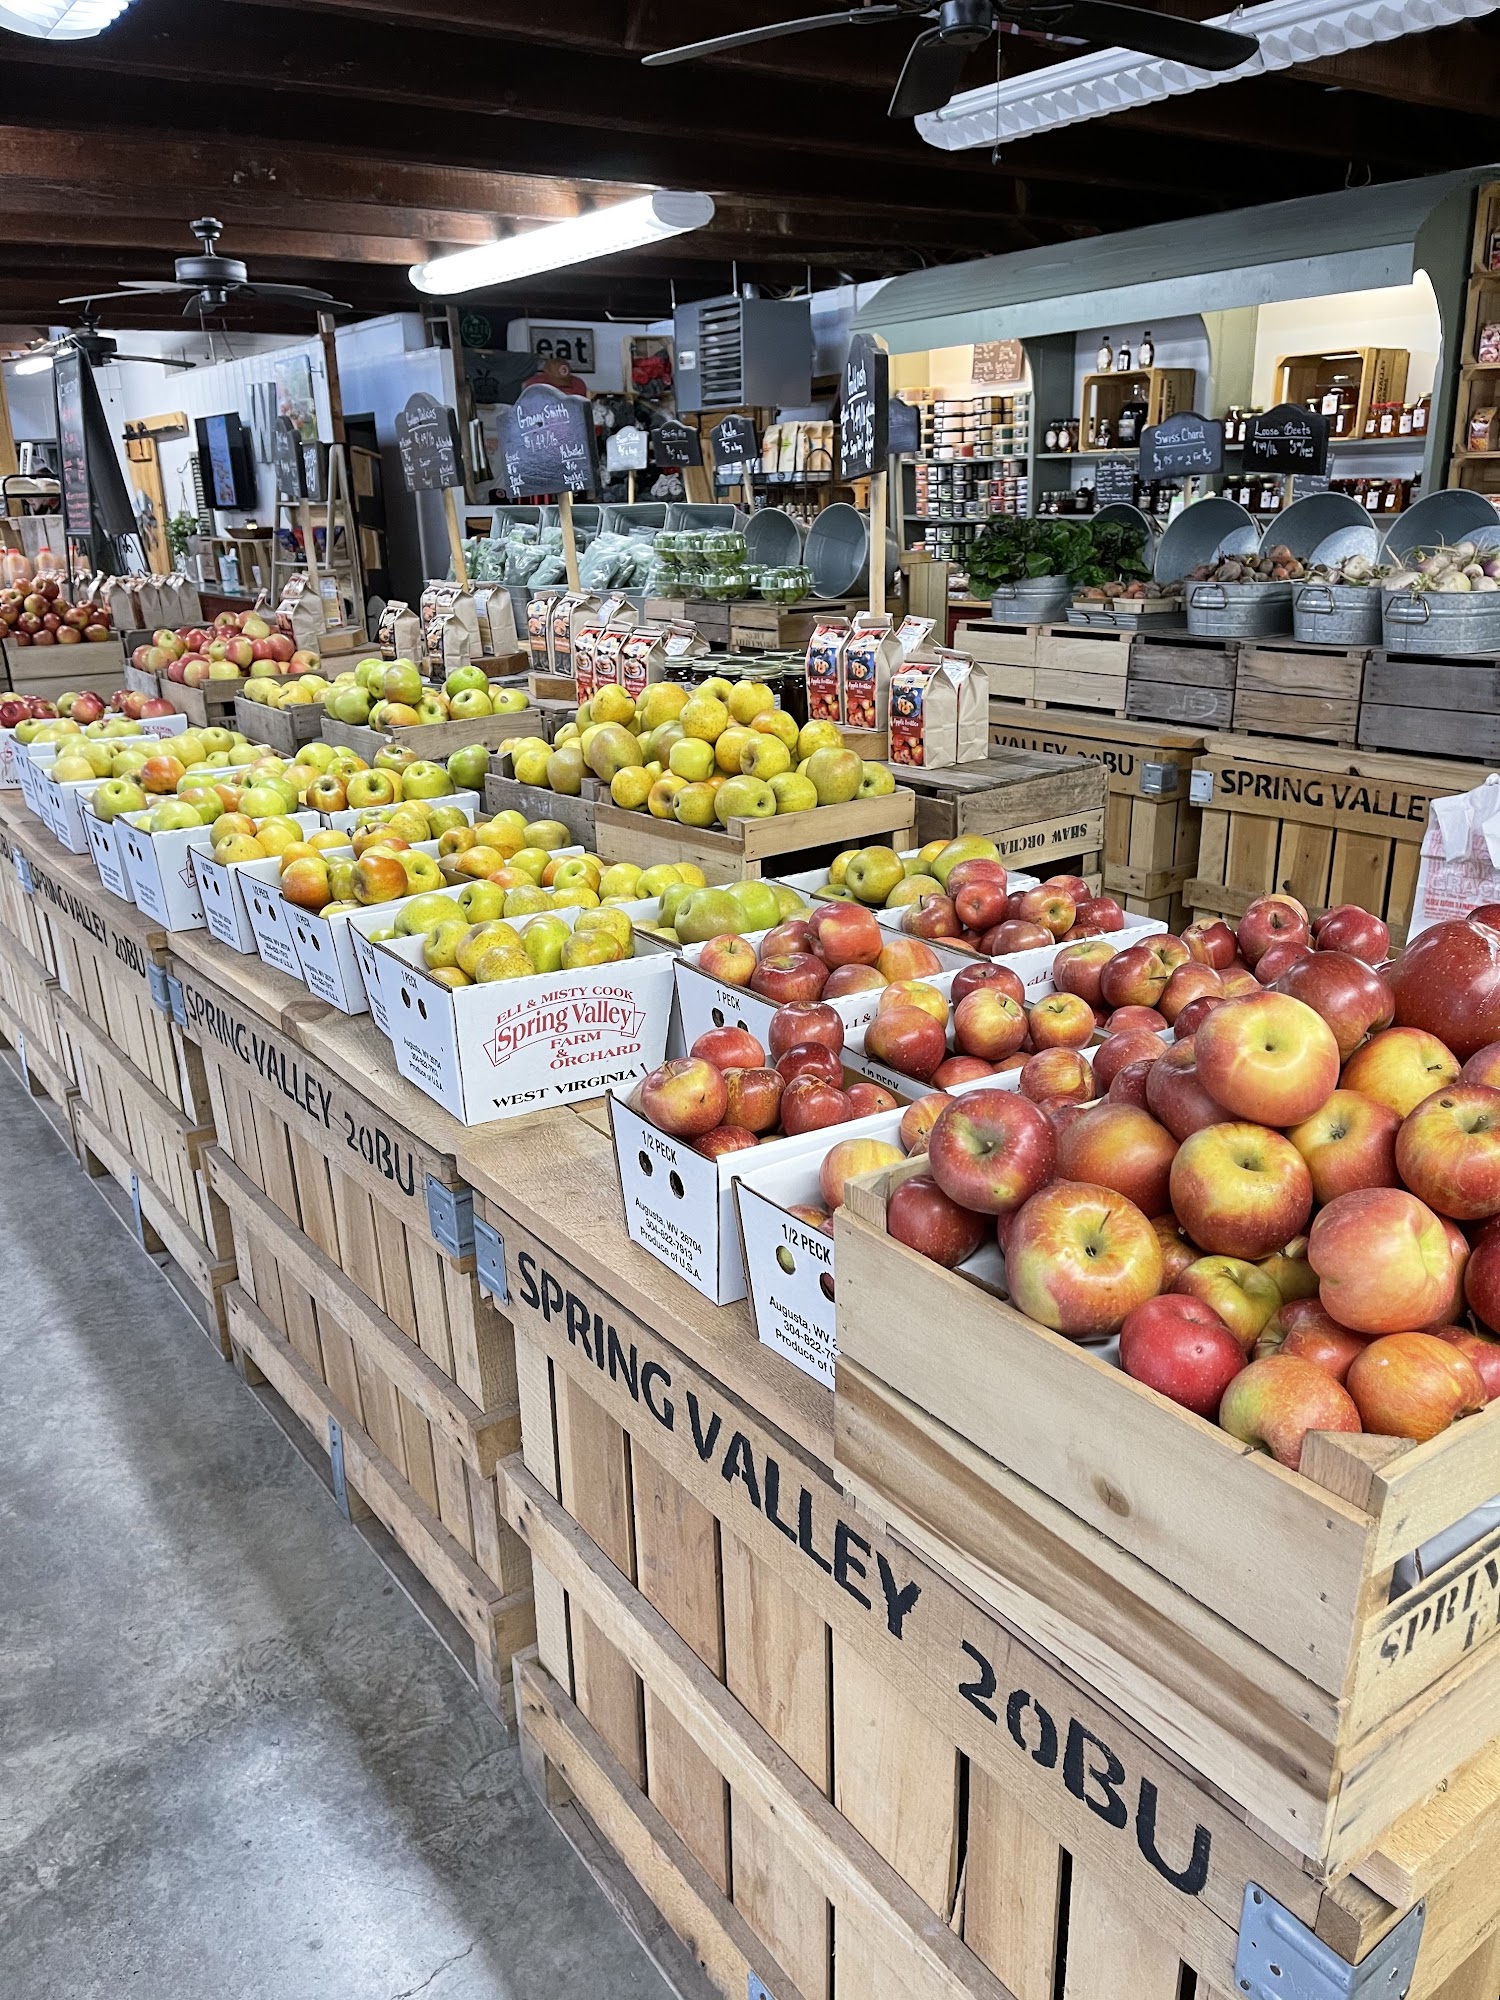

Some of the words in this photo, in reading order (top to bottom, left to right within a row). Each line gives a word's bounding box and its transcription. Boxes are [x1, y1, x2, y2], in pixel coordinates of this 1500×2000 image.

[536, 337, 588, 364] eat
[517, 405, 545, 429] Granny
[543, 403, 570, 419] Smith
[720, 420, 737, 439] Kale
[1254, 420, 1280, 436] Loose
[1283, 421, 1311, 436] Beets
[1154, 430, 1180, 446] Swiss
[1181, 426, 1206, 442] Chard
[1185, 454, 1192, 466] 2
[1202, 447, 1212, 465] $5
[1220, 769, 1324, 807] SPRING
[1331, 784, 1432, 823] VALLE
[1051, 822, 1088, 845] SHAW
[30, 861, 69, 915] SPRING
[65, 890, 109, 949] VALLEY
[112, 930, 147, 979] 20BU
[405, 972, 419, 990] PECK
[496, 1003, 522, 1025] ELI
[526, 999, 536, 1009] &
[540, 986, 588, 1005] MISTY
[592, 986, 634, 1001] COOK
[716, 989, 721, 1002] 1
[722, 991, 741, 1012] PECK
[497, 1006, 569, 1053] Spring
[571, 1000, 632, 1031] Valley
[550, 1030, 601, 1050] FARM
[549, 1042, 641, 1070] ORCHARD
[555, 1048, 569, 1059] &
[186, 983, 251, 1065] SPRING
[252, 1032, 333, 1130] VALLEY
[344, 1110, 416, 1198] 20BU
[492, 1087, 549, 1108] WEST
[554, 1069, 638, 1094] VIRGINIA
[641, 1130, 655, 1150] 1/2
[655, 1138, 678, 1166] PECK
[635, 1197, 666, 1230] Augusta,
[665, 1219, 679, 1237] WV
[640, 1226, 670, 1256] Produce
[670, 1250, 679, 1263] of
[678, 1257, 702, 1282] U.S.A.
[782, 1223, 799, 1247] 1/2
[800, 1233, 832, 1266] PECK
[769, 1295, 812, 1334] Augusta,
[812, 1323, 830, 1345] WV
[775, 1328, 815, 1364] Produce
[817, 1360, 829, 1373] of
[516, 1250, 676, 1433] SPRING
[686, 1389, 924, 1641] VALLEY
[957, 1637, 1212, 1897] 20BU
